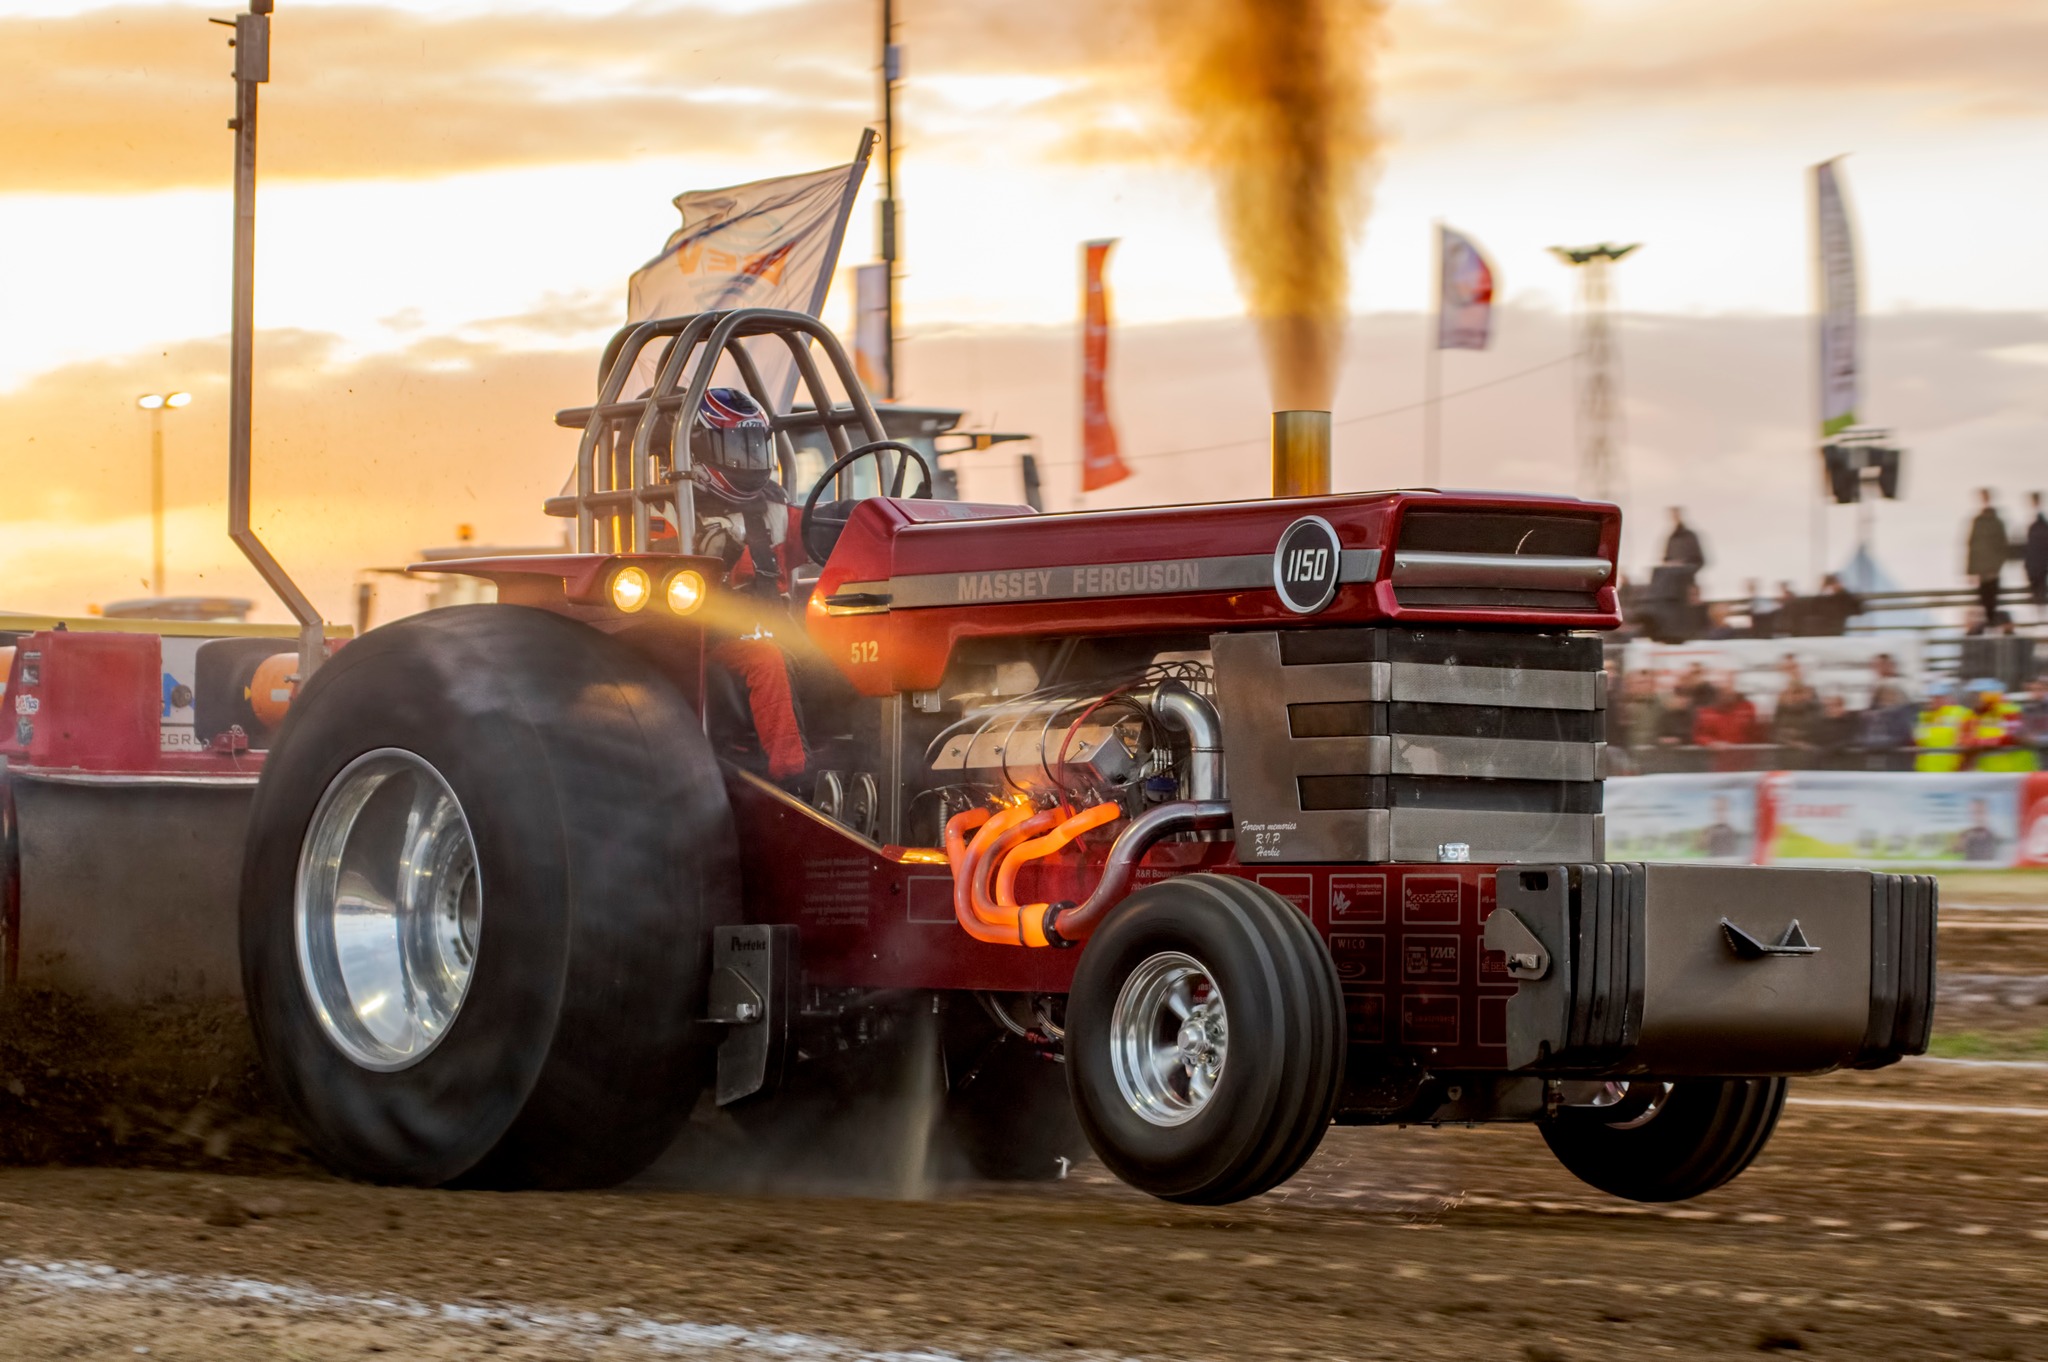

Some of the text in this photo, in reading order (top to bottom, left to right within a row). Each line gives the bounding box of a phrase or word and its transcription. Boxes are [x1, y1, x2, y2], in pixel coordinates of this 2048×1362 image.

[1286, 549, 1328, 582] 1150
[958, 562, 1199, 600] MASSEY FERGUSON
[851, 640, 879, 664] 512
[1241, 820, 1297, 833] Forever memories
[1337, 938, 1366, 949] WICO
[1430, 946, 1457, 959] VMR
